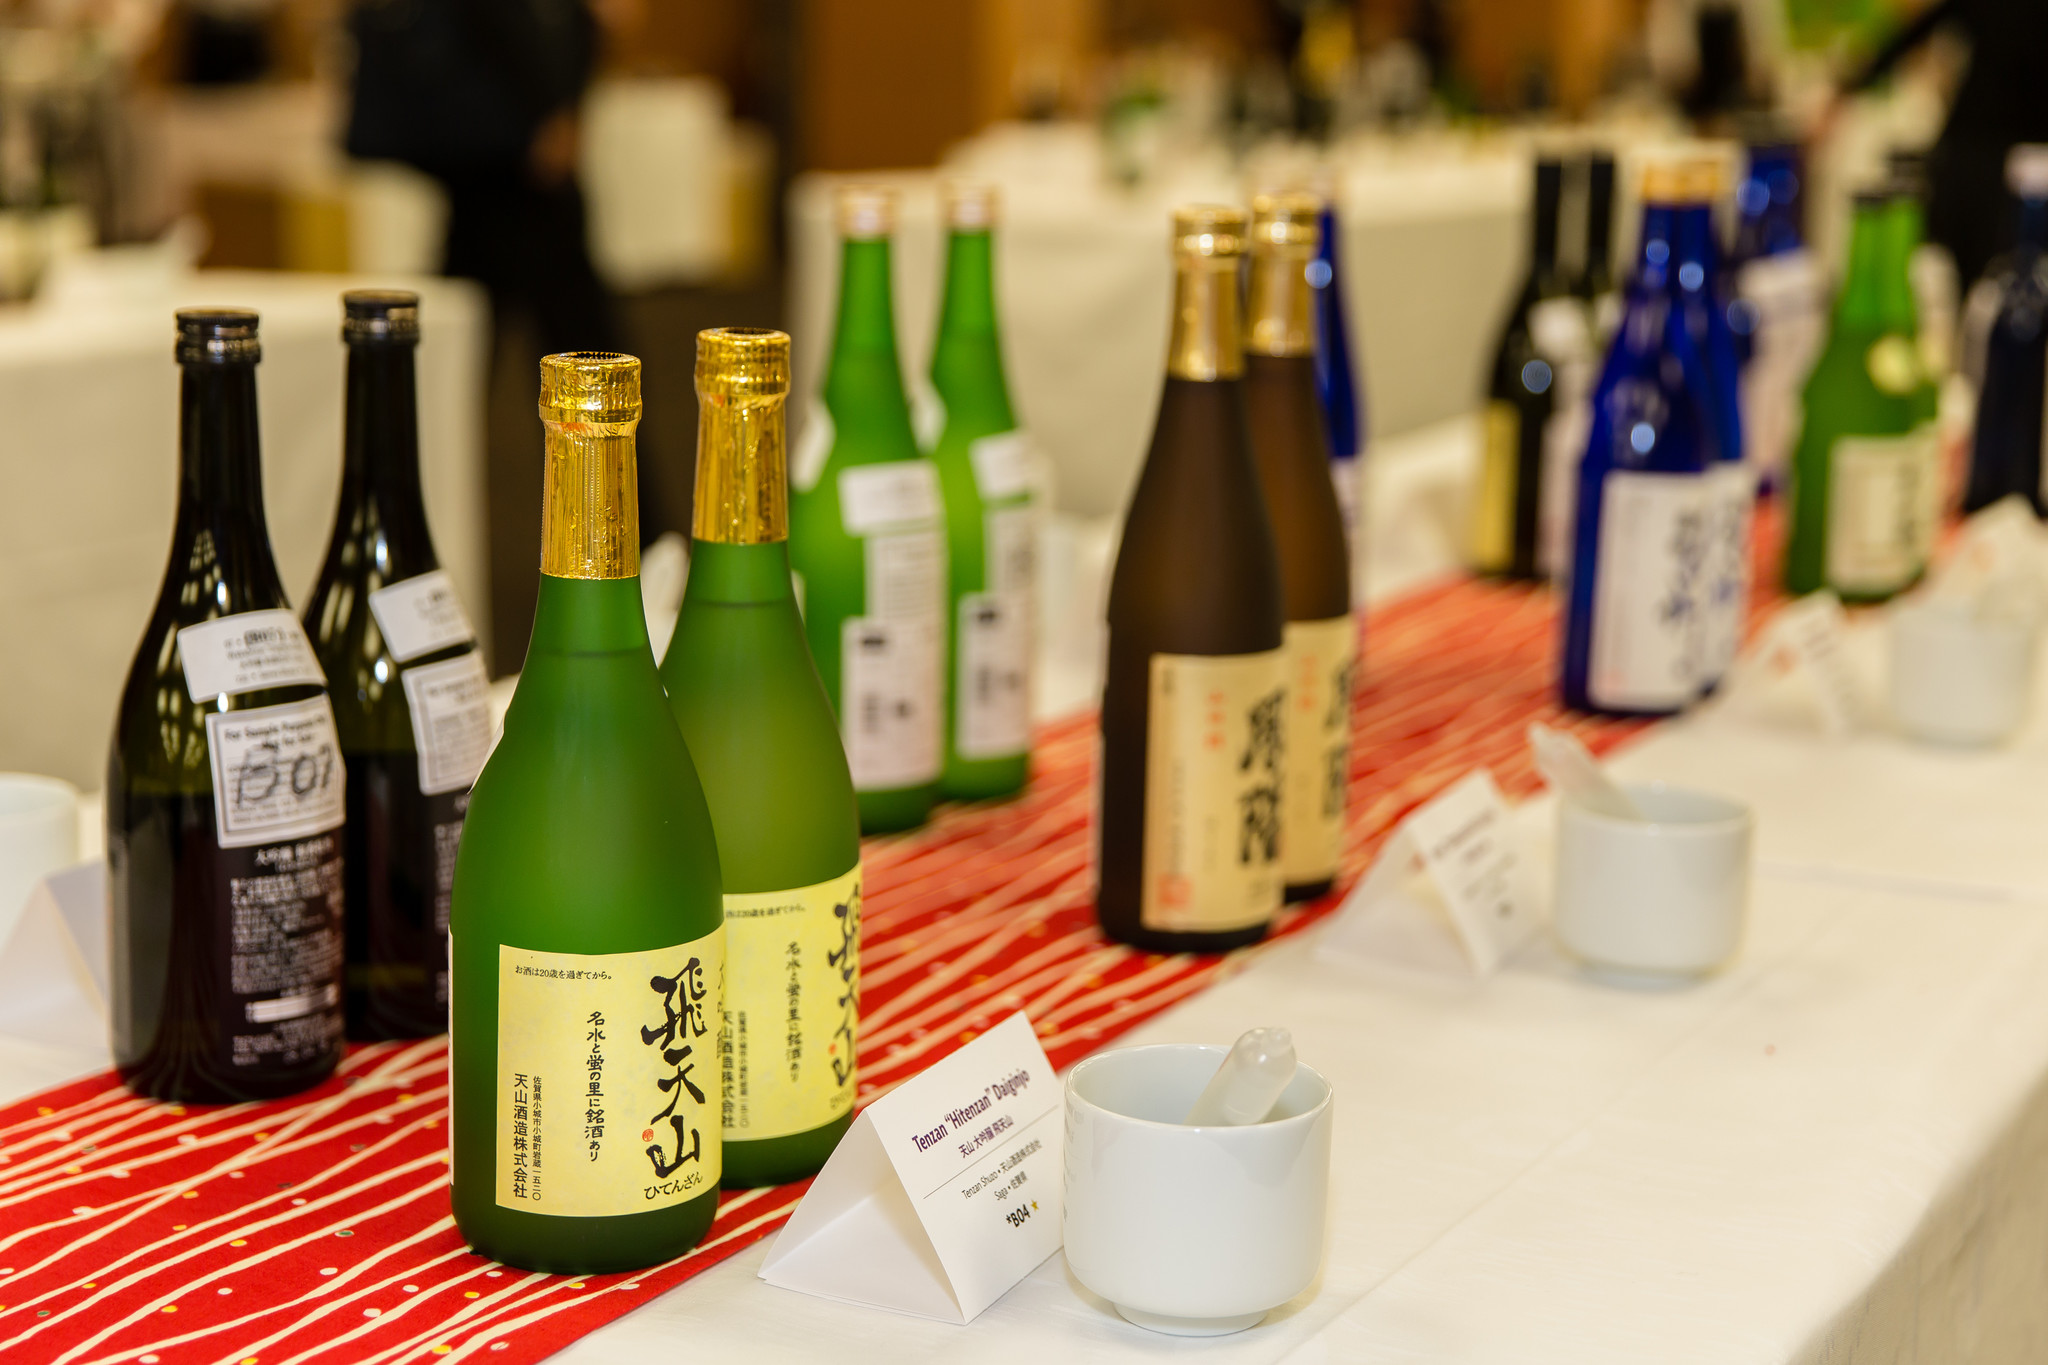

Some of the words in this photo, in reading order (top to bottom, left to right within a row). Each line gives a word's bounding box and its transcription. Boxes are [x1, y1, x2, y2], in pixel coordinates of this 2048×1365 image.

[514, 964, 613, 981] お酒は20歳を過ぎてから。
[585, 1010, 606, 1162] 名水と蛍の里に銘酒あり
[640, 956, 708, 1179] 飛天山
[513, 1072, 529, 1199] 天山酒造株式会社
[532, 1075, 542, 1201] 佐賀県小城市小城町岩蔵一五二〇
[911, 1123, 949, 1153] Tenzan
[991, 1068, 1031, 1101] Daiginjo
[958, 1140, 975, 1158] 天山
[643, 1171, 704, 1200] ひてんざん
[961, 1181, 983, 1200] Tenzan
[980, 1169, 999, 1187] Shuzo
[994, 1186, 1009, 1201] Saga
